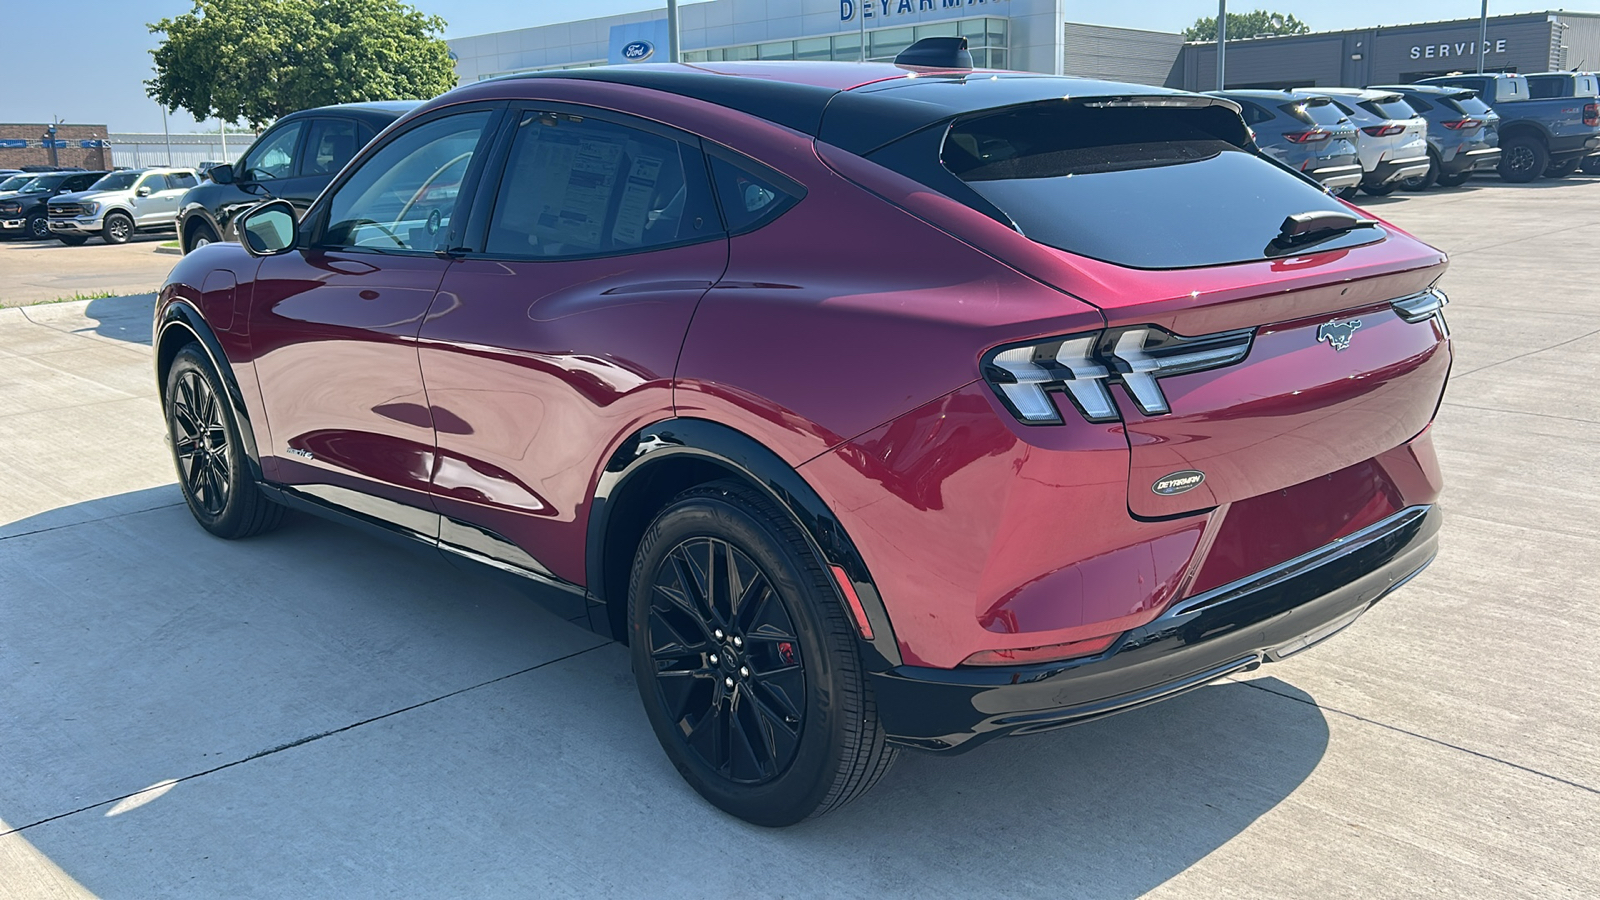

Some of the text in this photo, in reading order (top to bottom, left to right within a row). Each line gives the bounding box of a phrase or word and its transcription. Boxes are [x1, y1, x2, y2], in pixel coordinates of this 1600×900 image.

[840, 0, 998, 20] DEYAR
[626, 44, 645, 57] Ford
[1410, 39, 1507, 59] SERVICE
[1157, 475, 1201, 490] DEYARMAN
